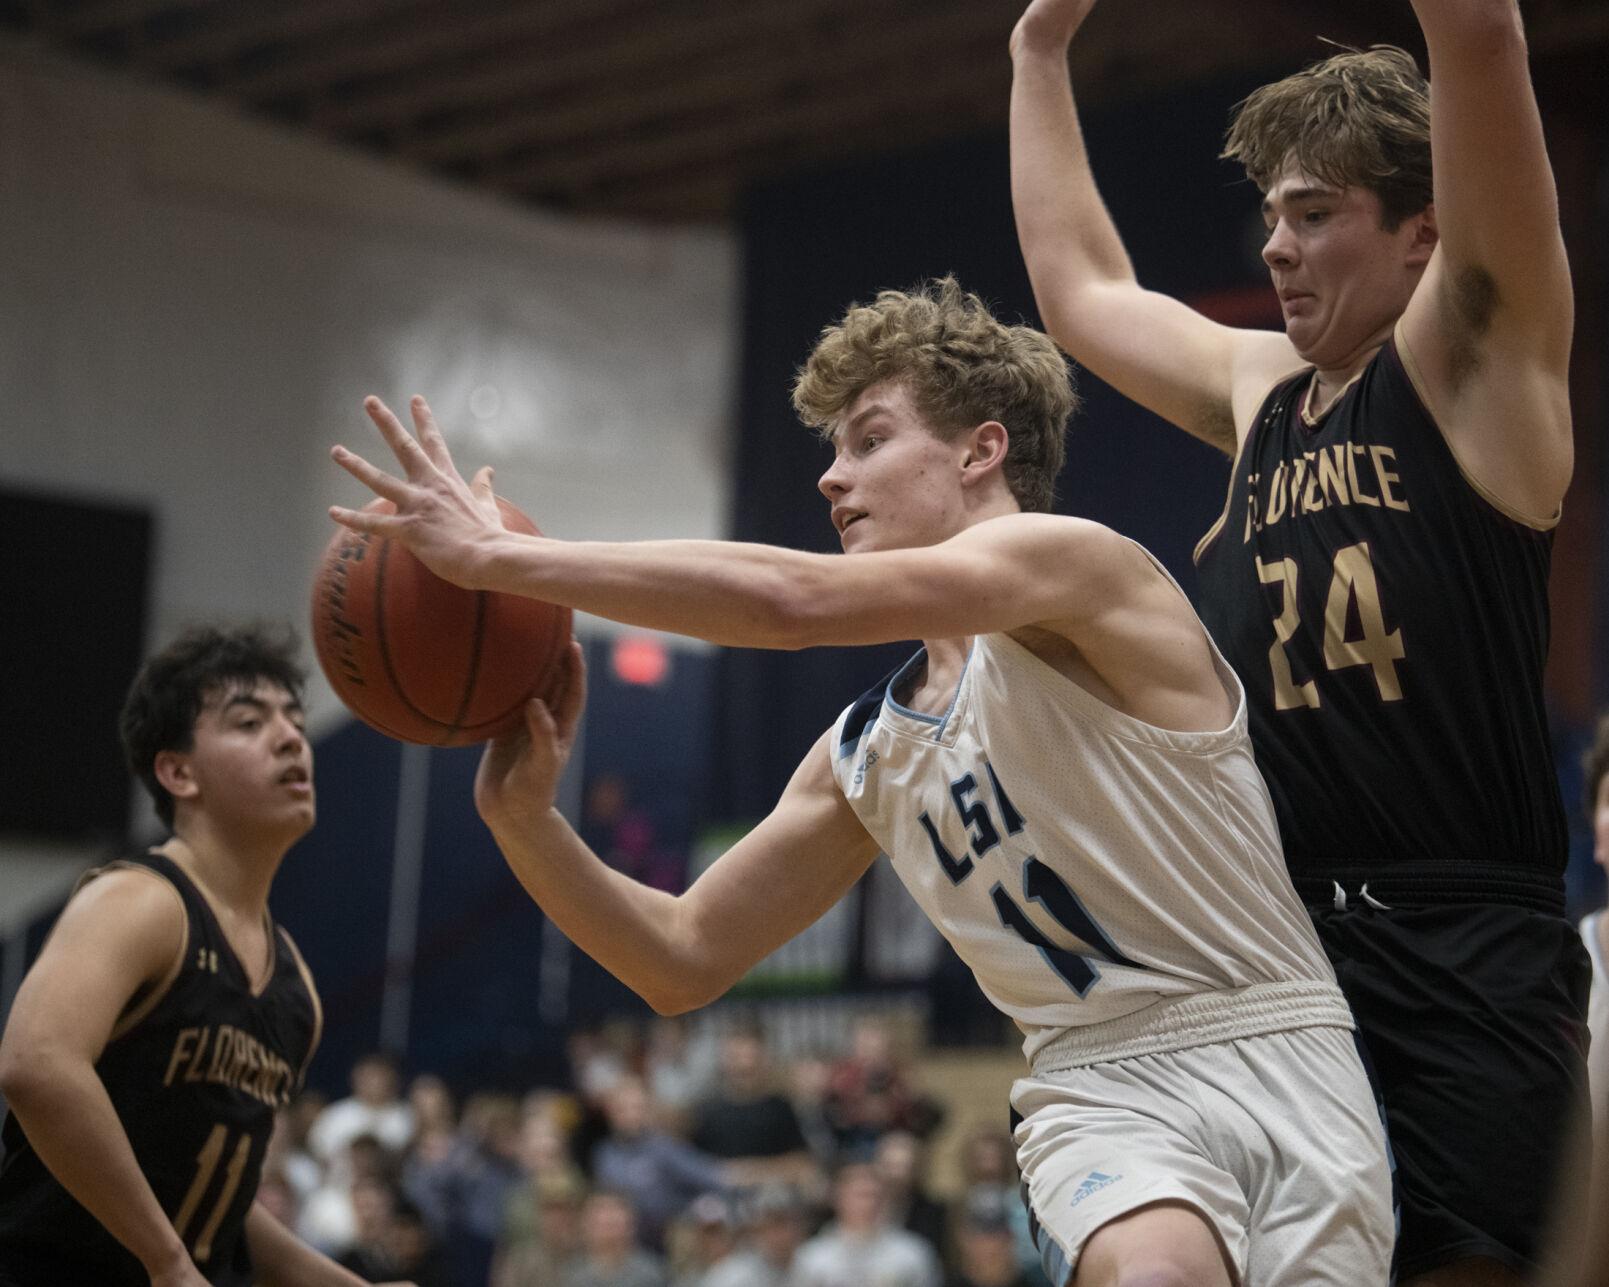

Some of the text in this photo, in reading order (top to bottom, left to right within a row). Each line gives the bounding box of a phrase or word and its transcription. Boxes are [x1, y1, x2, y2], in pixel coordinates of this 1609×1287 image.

[1243, 441, 1411, 544] ORENCE
[1255, 541, 1406, 711] 24
[989, 854, 1150, 1000] 11
[163, 1024, 293, 1107] FLORENC
[174, 1122, 252, 1261] 11
